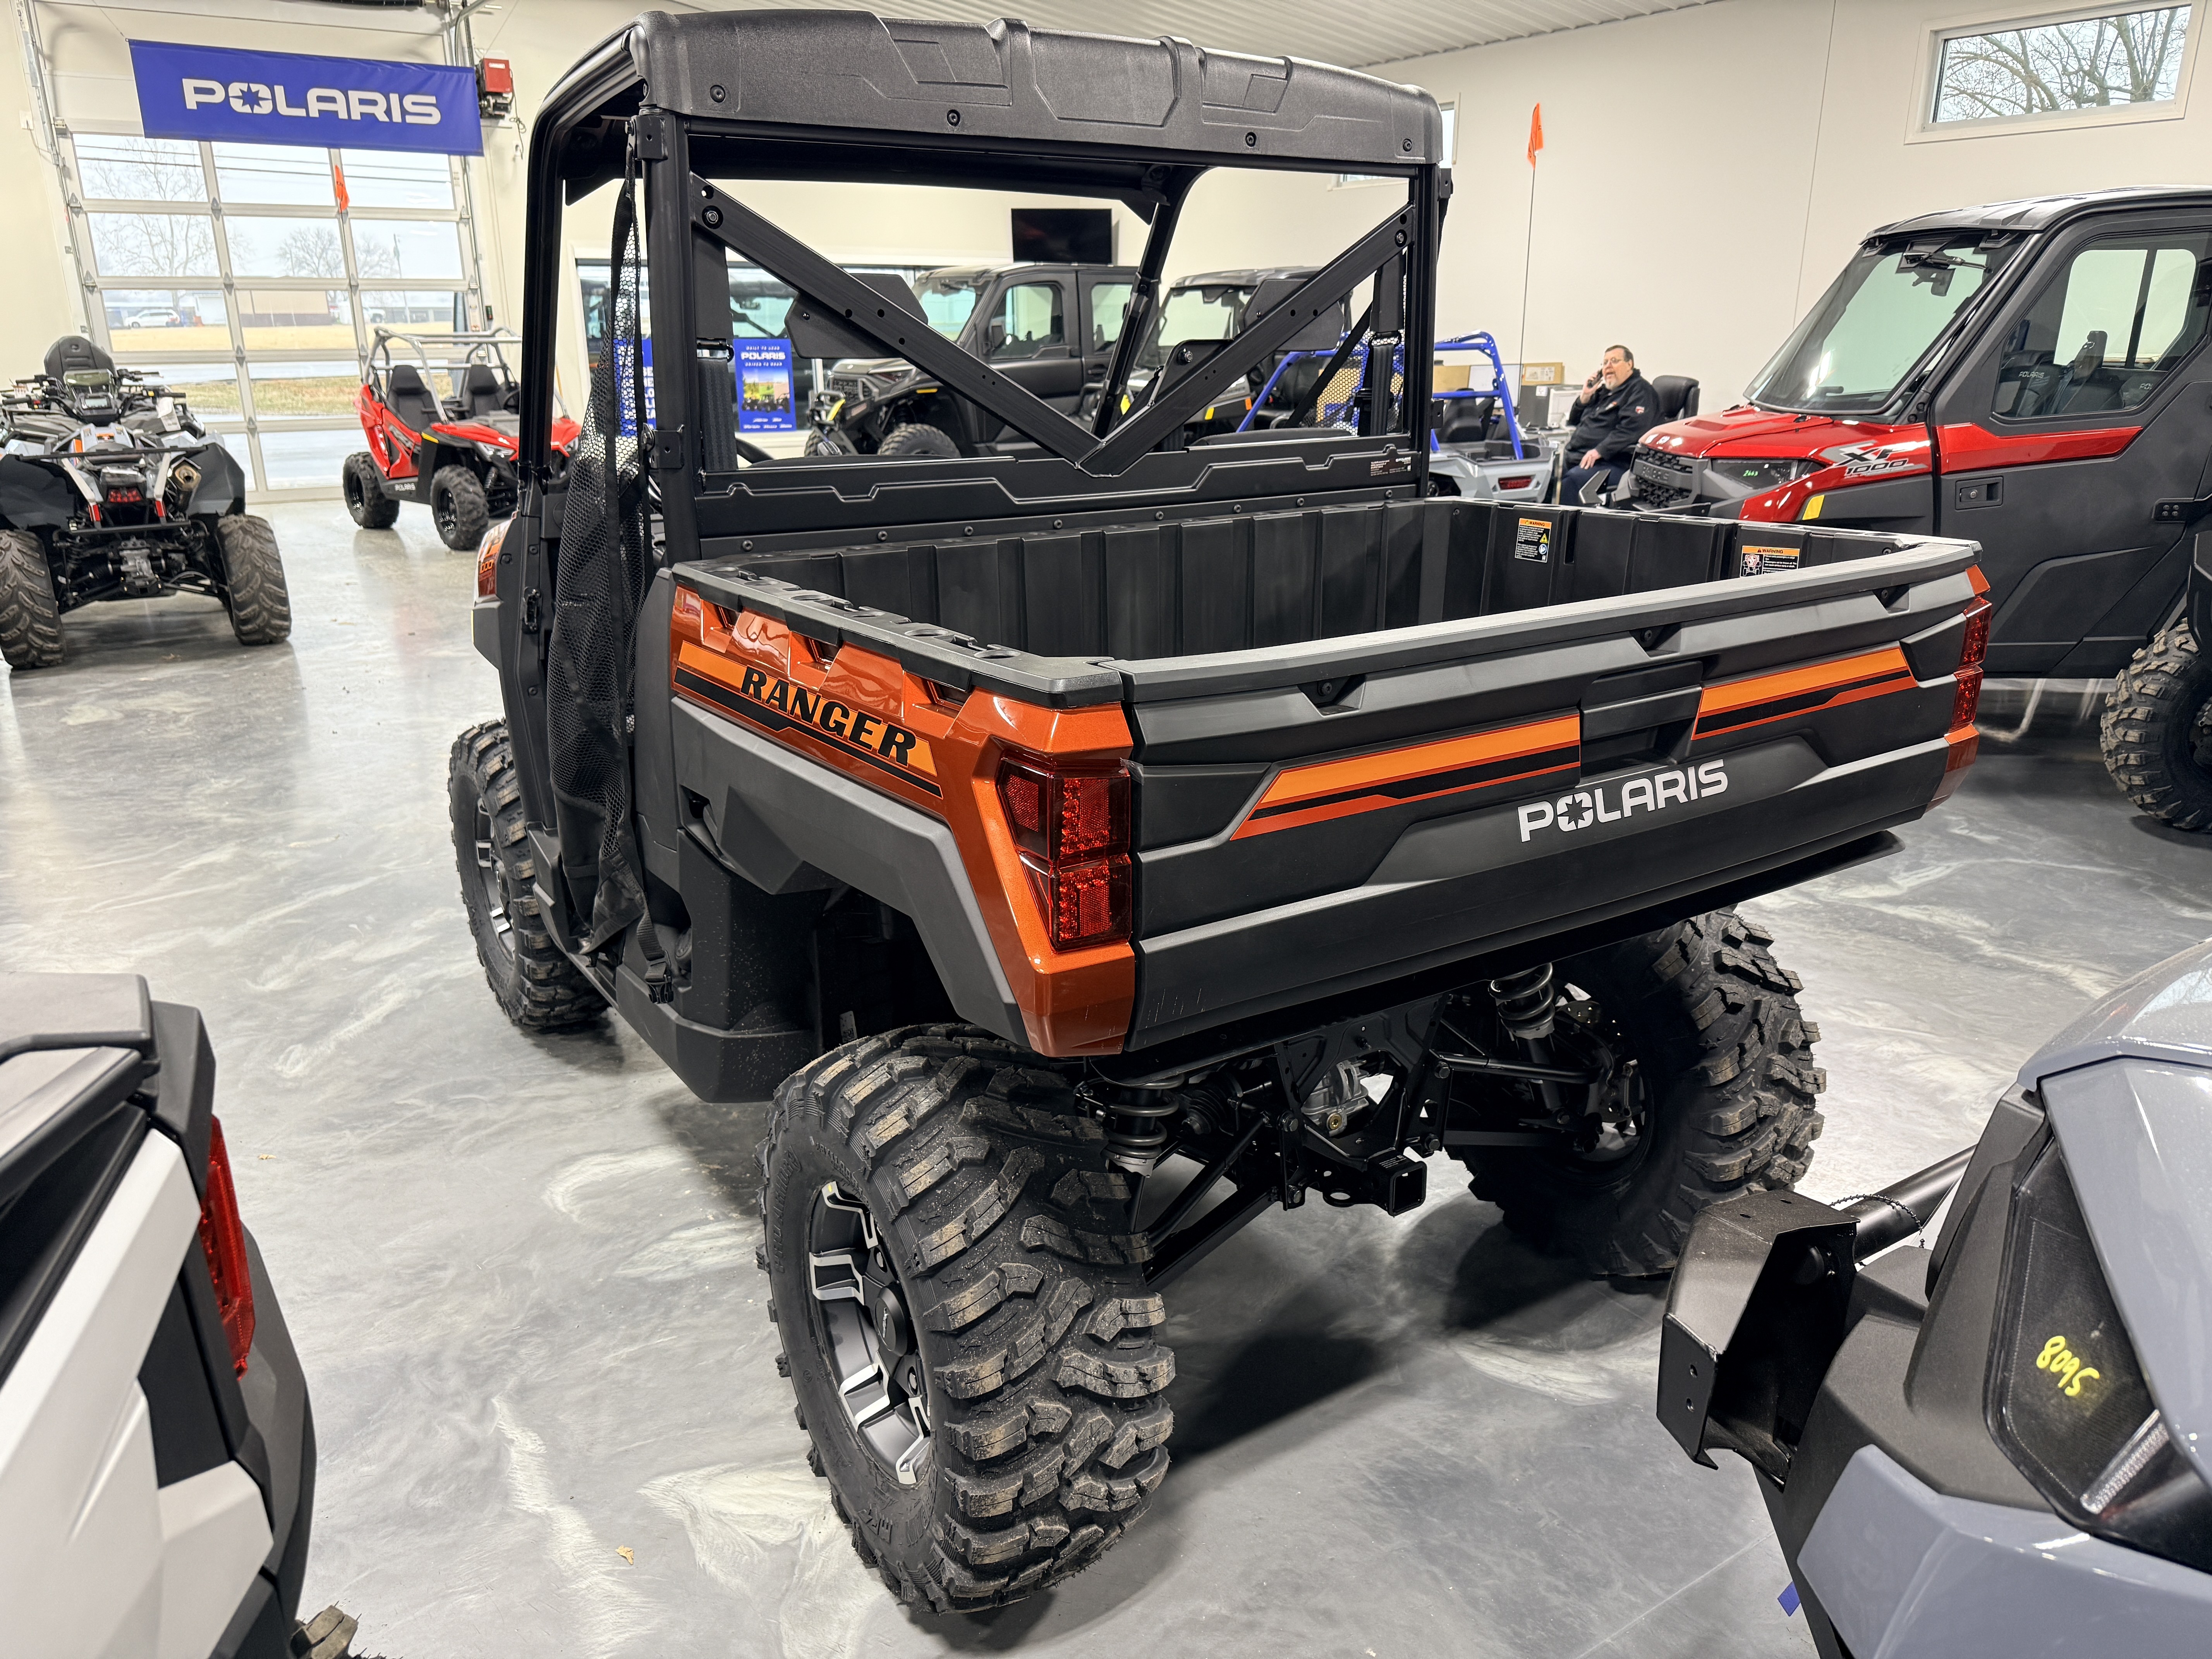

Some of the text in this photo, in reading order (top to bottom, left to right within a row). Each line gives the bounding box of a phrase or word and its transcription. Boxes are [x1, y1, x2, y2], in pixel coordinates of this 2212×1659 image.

[182, 78, 441, 125] POLARIS
[741, 352, 785, 360] POLARIS
[1846, 459, 1908, 475] 1000
[740, 666, 916, 766] RANGER
[1518, 759, 1728, 842] POLARIS
[2036, 1336, 2100, 1396] 8095
